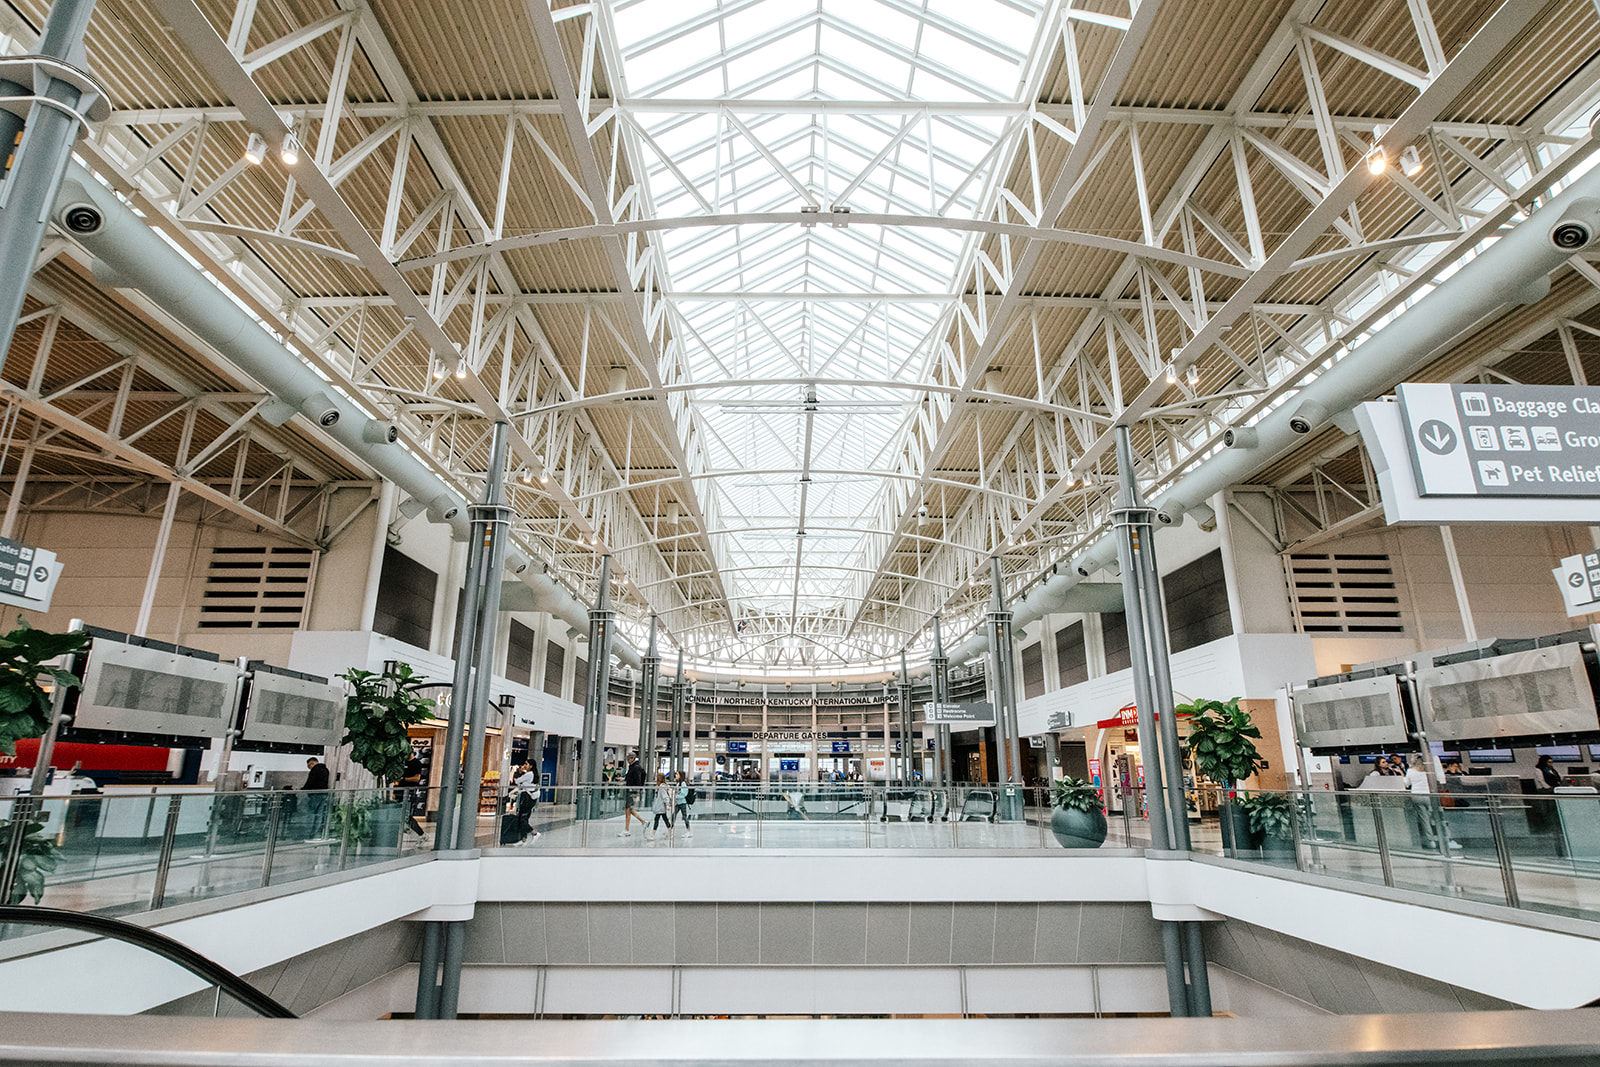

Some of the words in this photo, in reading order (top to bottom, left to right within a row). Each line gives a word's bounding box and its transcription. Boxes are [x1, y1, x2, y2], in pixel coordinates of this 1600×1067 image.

[1492, 396, 1567, 418] Baggage
[1572, 397, 1600, 414] Cla
[1564, 431, 1600, 448] Gro
[1510, 465, 1544, 482] Pet
[1547, 465, 1600, 483] Relief
[685, 695, 717, 703] NCINNATI
[724, 697, 766, 705] NORTHERN
[768, 698, 809, 706] KENTUCKY
[811, 697, 871, 705] INTERNATIONAL
[873, 695, 899, 704] AIRPOR
